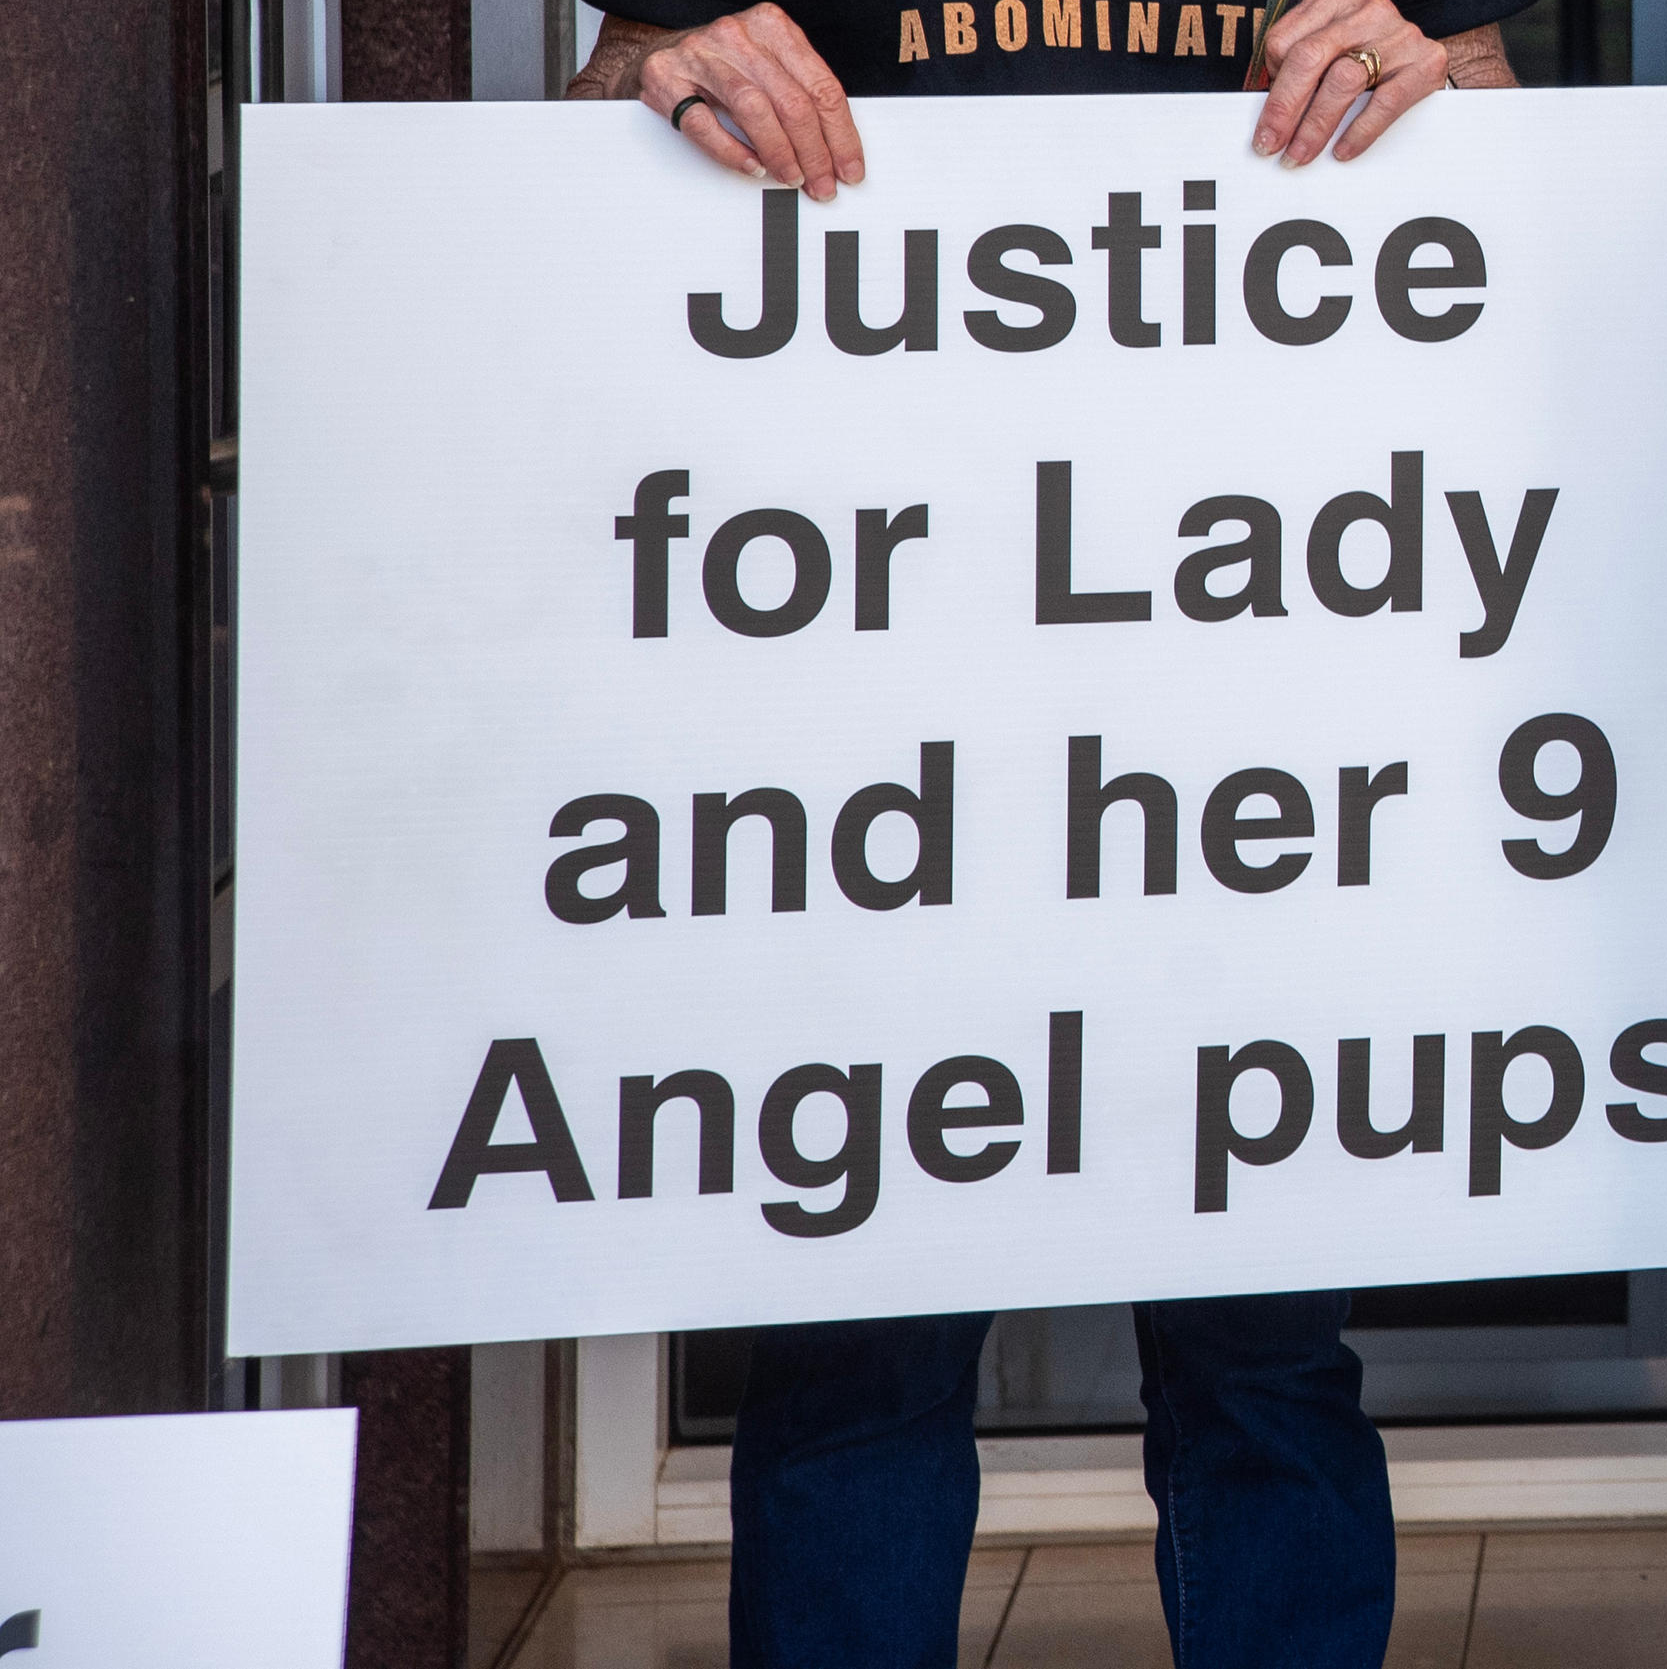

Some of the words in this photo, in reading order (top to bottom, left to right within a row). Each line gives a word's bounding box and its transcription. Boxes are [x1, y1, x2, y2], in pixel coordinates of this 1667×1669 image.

[687, 179, 1487, 359] Justice
[614, 469, 929, 639] for
[1035, 450, 1561, 659] Lady
[544, 740, 955, 925] and
[1066, 734, 1409, 900] her
[1498, 712, 1618, 881] 9
[426, 1010, 1084, 1239] Angel
